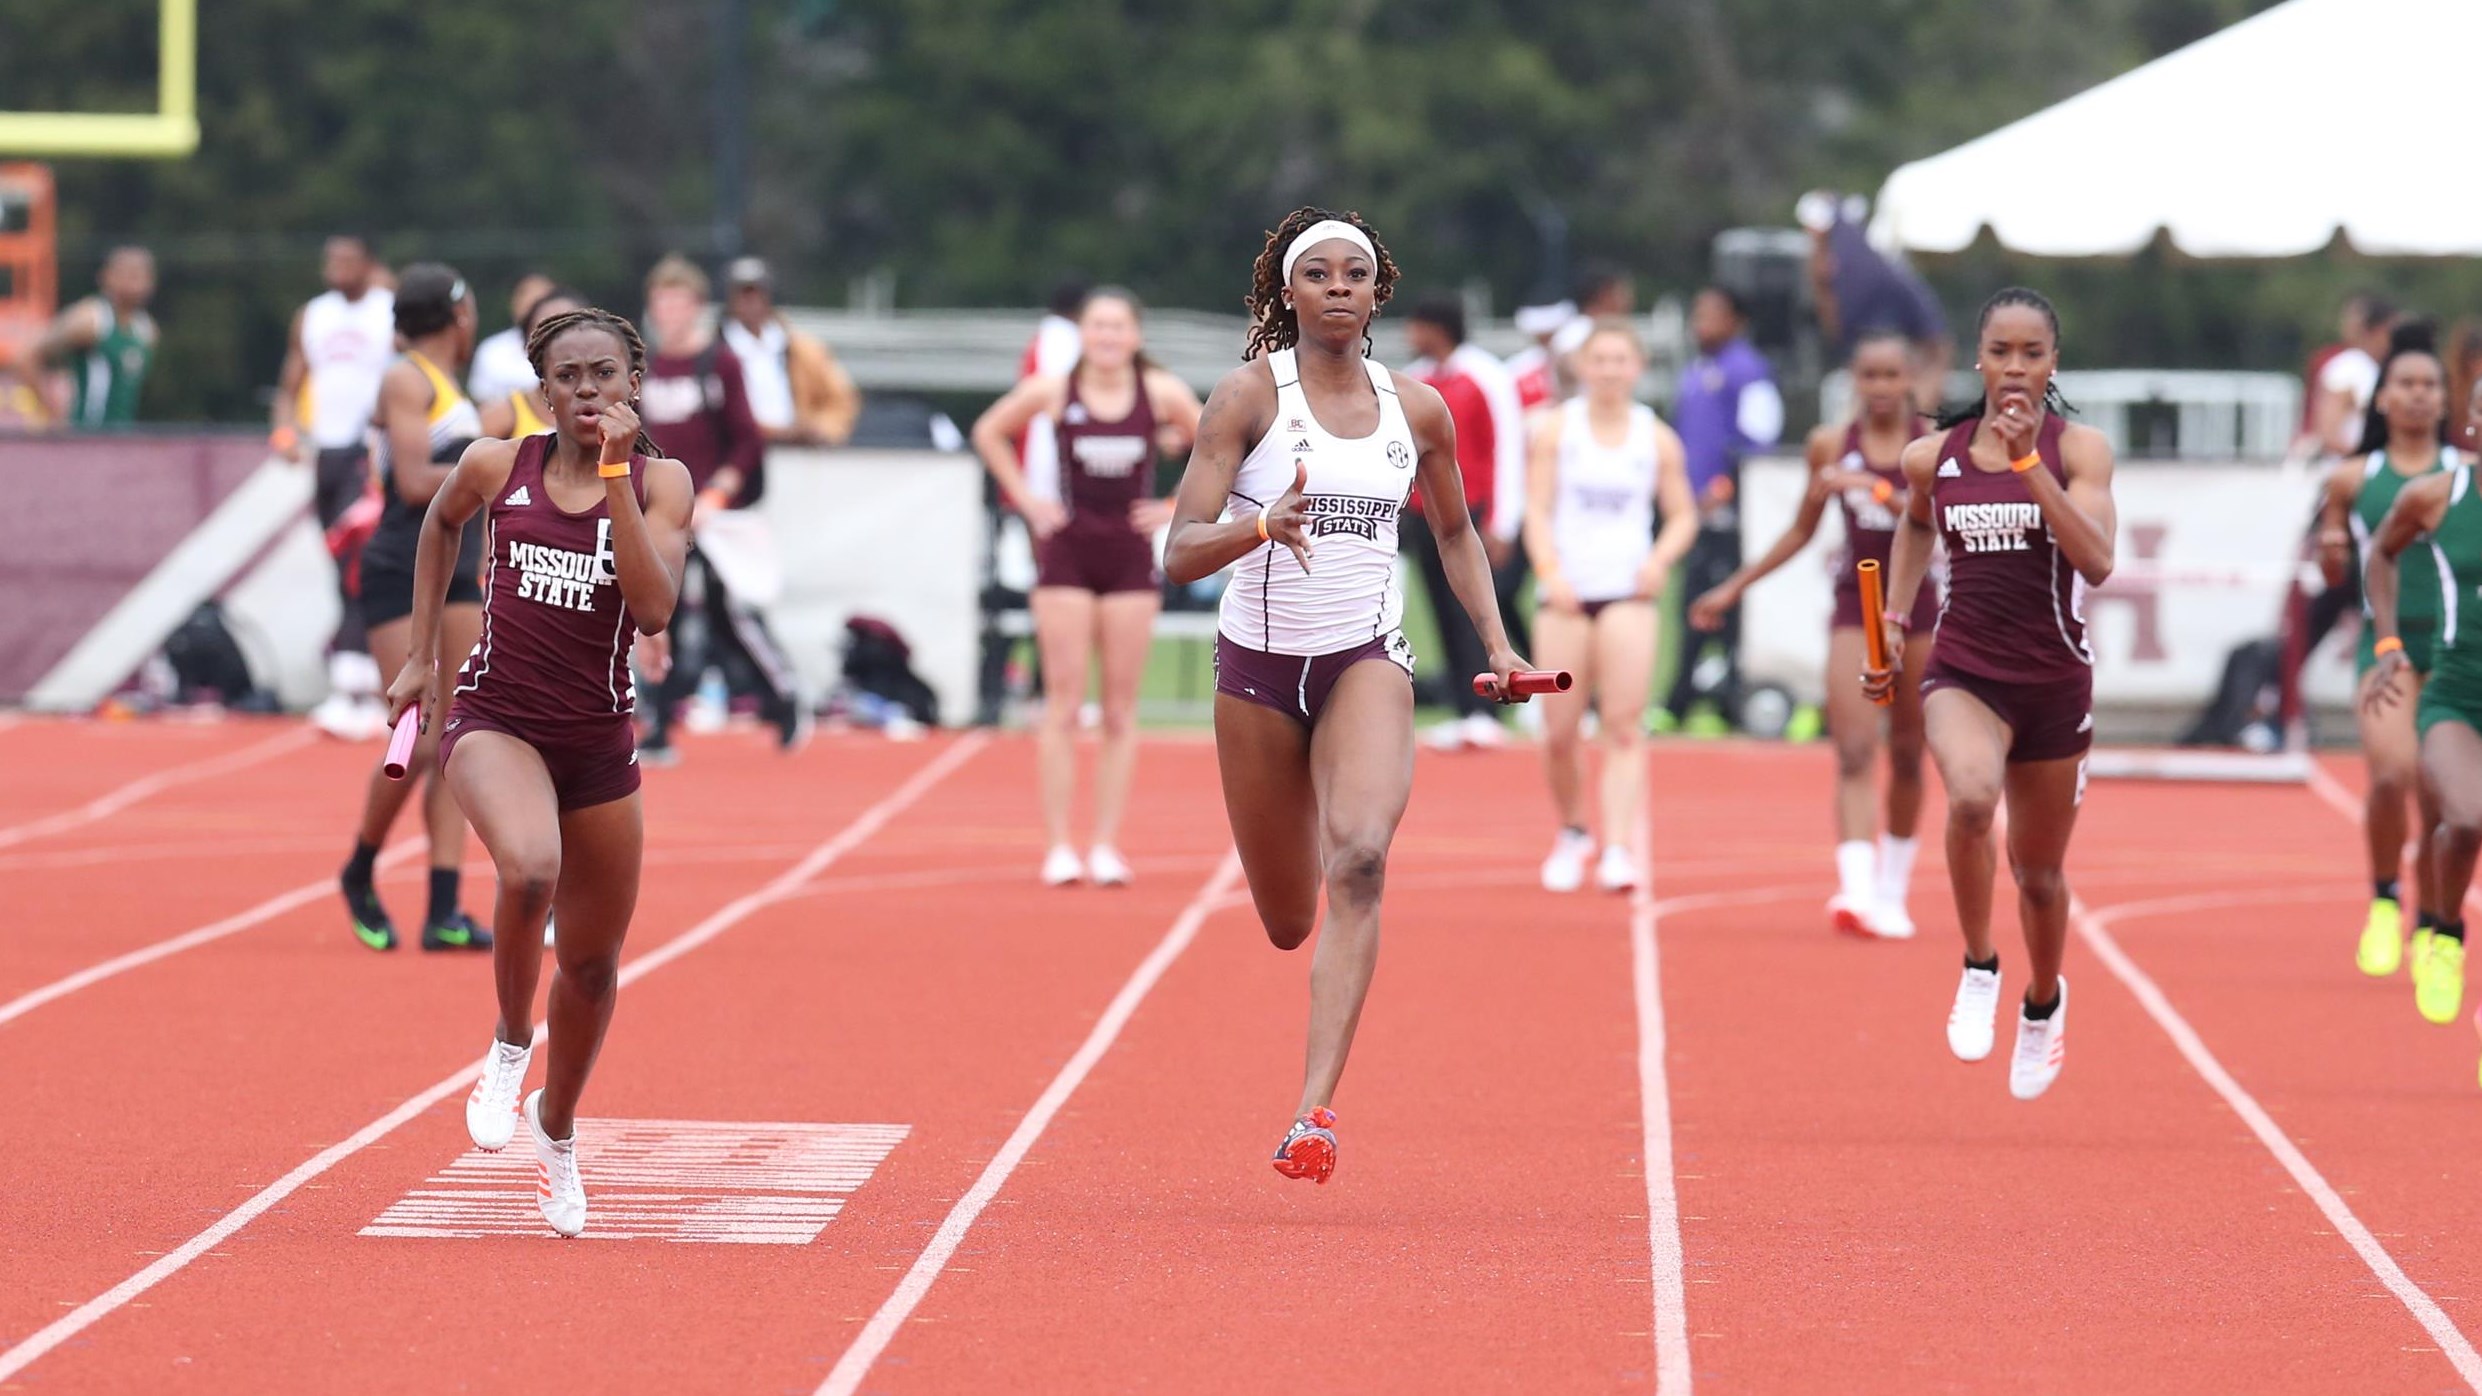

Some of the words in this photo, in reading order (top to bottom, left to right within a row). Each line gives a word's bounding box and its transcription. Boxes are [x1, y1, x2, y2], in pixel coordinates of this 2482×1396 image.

[1323, 520, 1370, 535] STATE
[1944, 503, 2040, 532] MISSOURI
[1960, 527, 2028, 552] STATE
[509, 540, 612, 586] MISSOU
[517, 571, 595, 611] STATE
